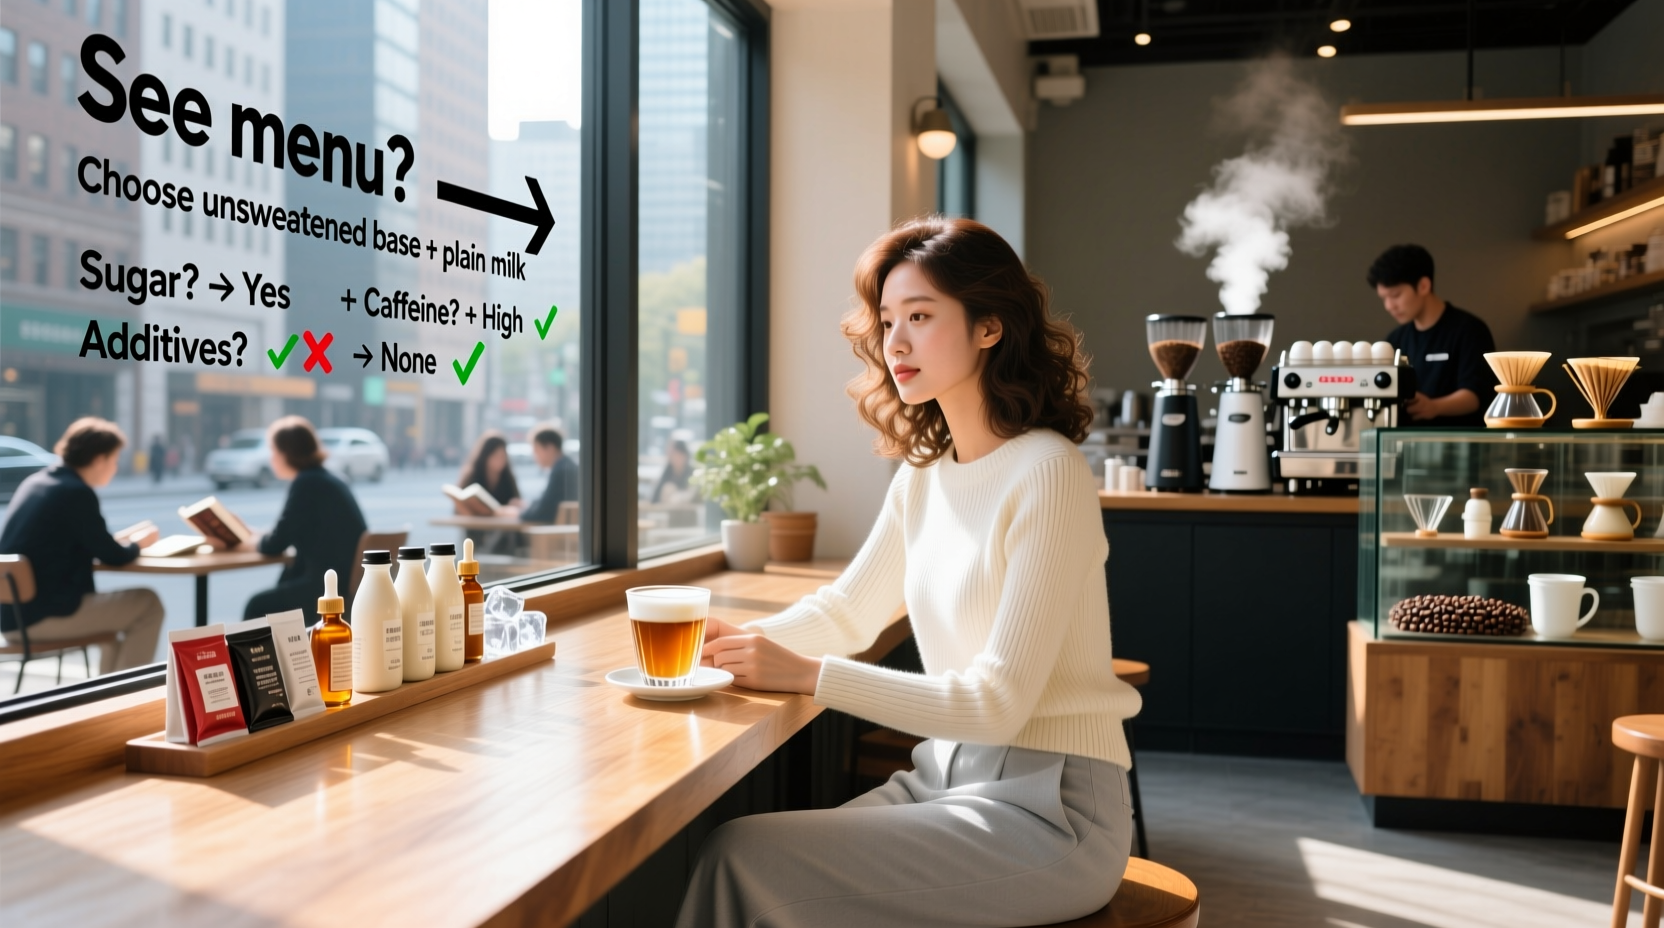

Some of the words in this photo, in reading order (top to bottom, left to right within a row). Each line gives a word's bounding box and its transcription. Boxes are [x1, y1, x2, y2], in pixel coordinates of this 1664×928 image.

[77, 33, 212, 147] See
[231, 103, 415, 203] menu?
[77, 155, 194, 213] Choose
[203, 191, 367, 248] unsweatened
[373, 219, 421, 258] base
[442, 240, 486, 273] plain
[491, 251, 526, 281] milk
[78, 319, 248, 367] Additives?
[381, 341, 437, 375] None
[79, 249, 199, 306] Sugar?
[242, 271, 291, 310] Yes
[364, 286, 460, 326] Caffeine?
[482, 302, 523, 340] High
